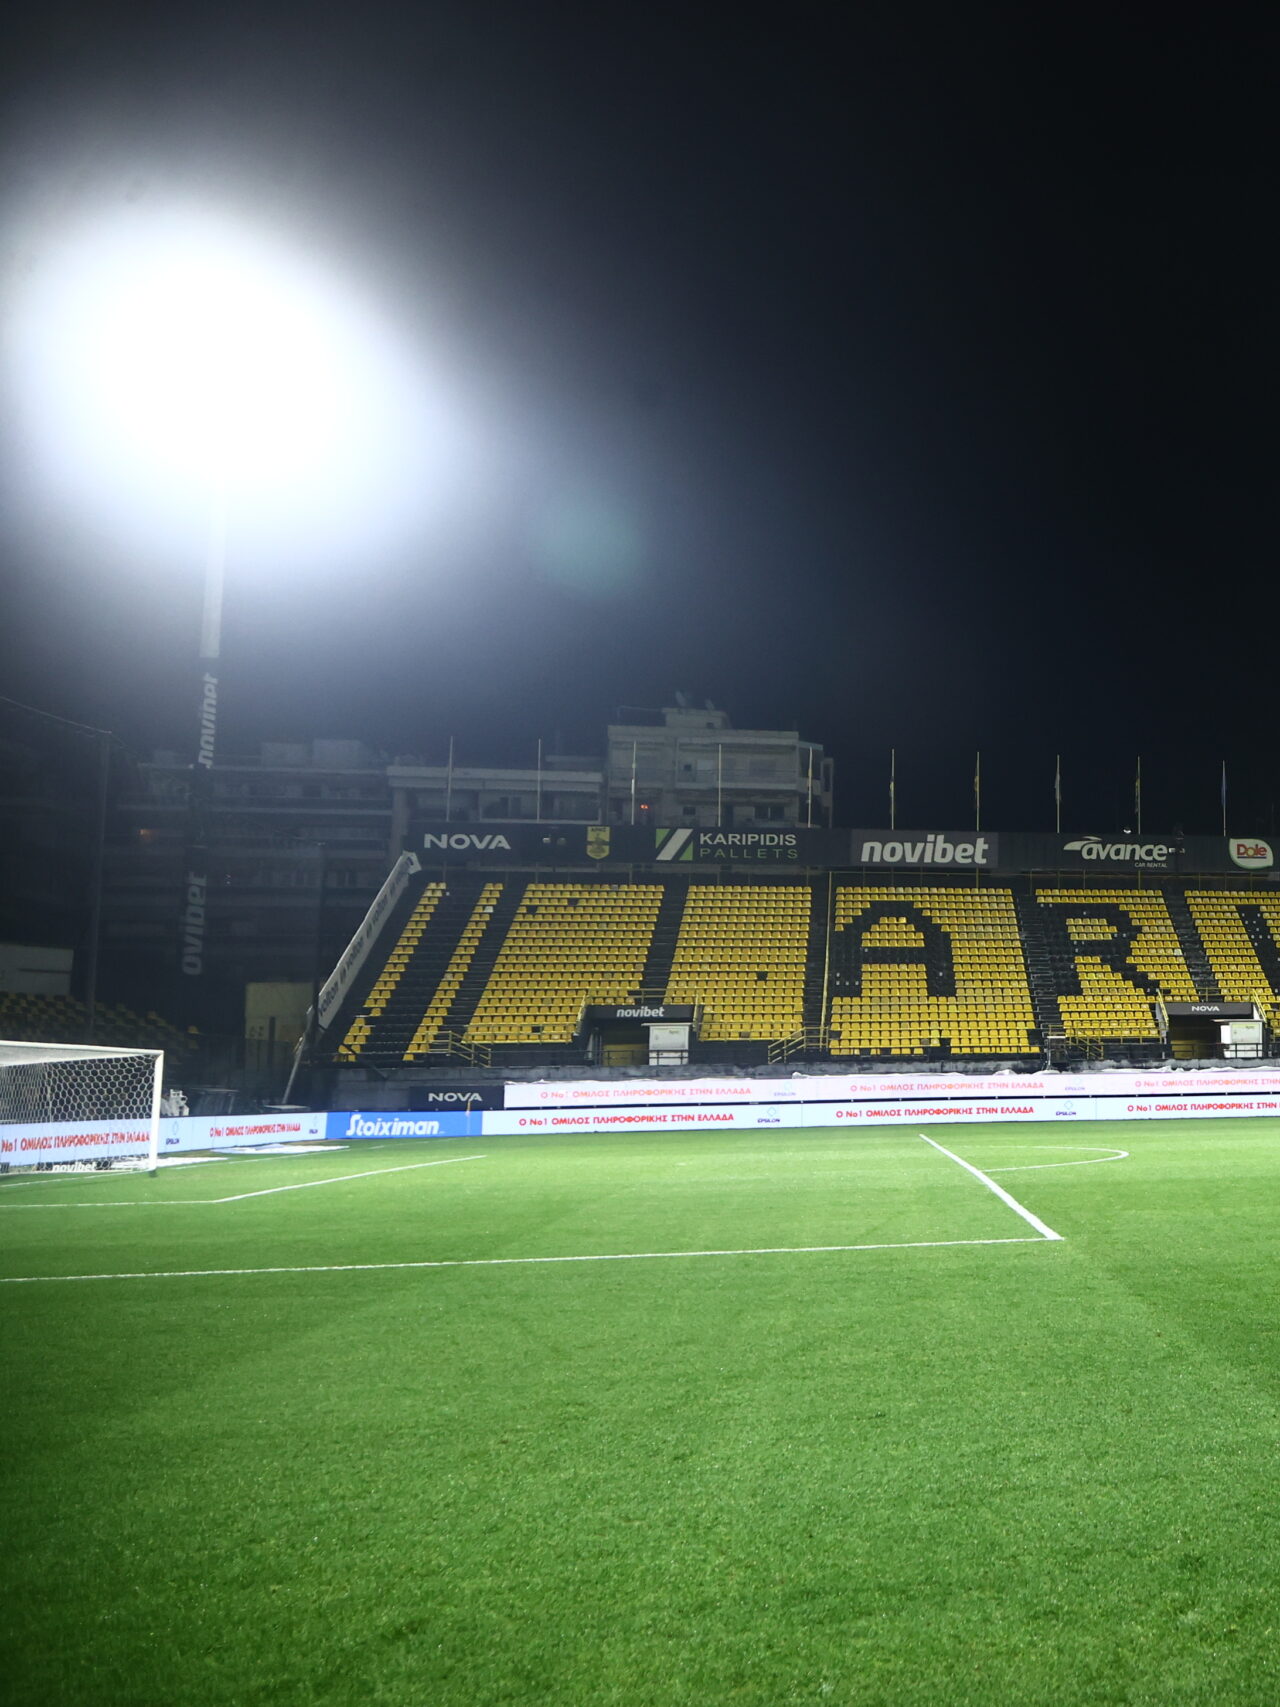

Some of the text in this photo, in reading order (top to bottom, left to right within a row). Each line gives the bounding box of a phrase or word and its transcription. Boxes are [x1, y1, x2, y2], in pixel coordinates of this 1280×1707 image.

[424, 833, 511, 849] NOVA
[700, 833, 797, 845] KARIPIDIS
[700, 848, 798, 859] PALLETS
[861, 834, 989, 864] novibet
[1081, 843, 1169, 861] avance
[1236, 844, 1268, 857] Dole
[616, 1006, 665, 1017] novibet
[428, 1092, 483, 1102] NOVA
[976, 1107, 998, 1115] ΣΤΗΝ
[1256, 1102, 1277, 1110] ΣΤΗΝ
[346, 1114, 441, 1136] Stoiximan
[551, 1117, 590, 1125] ΟΜΙΛΟΣ
[697, 1114, 734, 1122] ΕΛΛΑΔΑ
[52, 1161, 98, 1172] novibet
